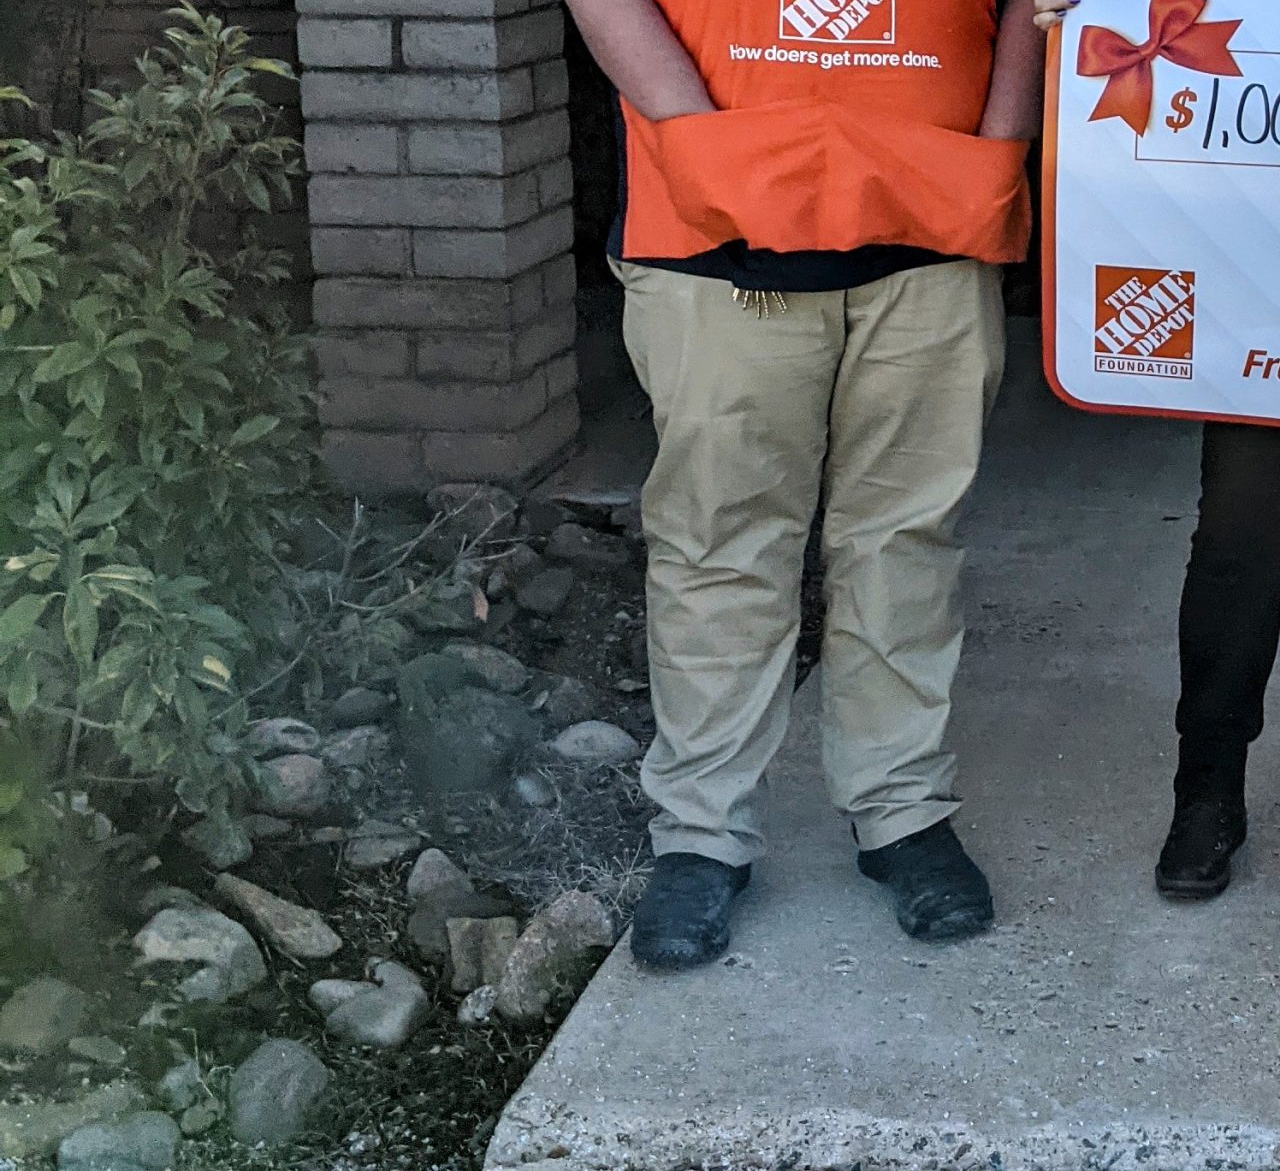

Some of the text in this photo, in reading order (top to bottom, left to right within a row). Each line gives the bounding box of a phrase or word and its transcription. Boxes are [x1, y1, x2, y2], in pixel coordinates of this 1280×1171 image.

[729, 43, 942, 69] How doers get more done.
[1104, 276, 1147, 310] THE
[1095, 269, 1195, 354] HOME
[1132, 303, 1195, 357] DEPOT
[1098, 359, 1189, 376] FOUNDATION
